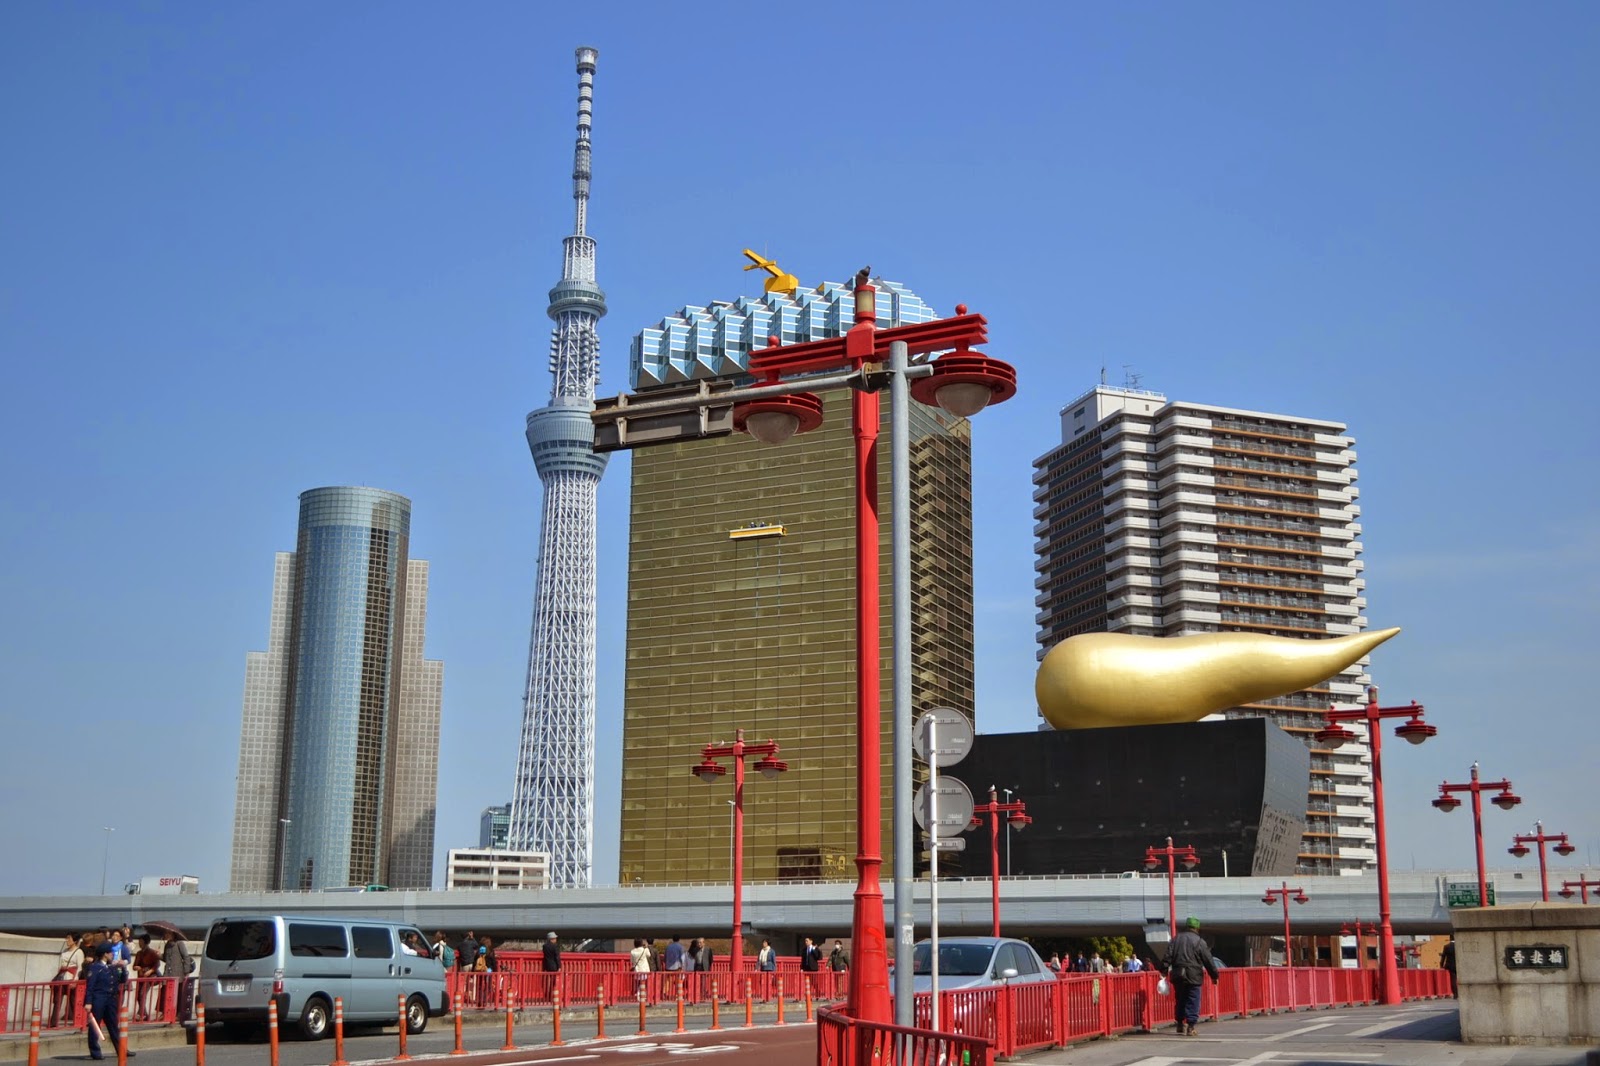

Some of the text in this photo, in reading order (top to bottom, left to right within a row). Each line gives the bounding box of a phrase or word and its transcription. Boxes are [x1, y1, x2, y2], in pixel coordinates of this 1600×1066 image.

[159, 878, 181, 886] SEIYU
[1511, 949, 1563, 964] 吾妻橋
